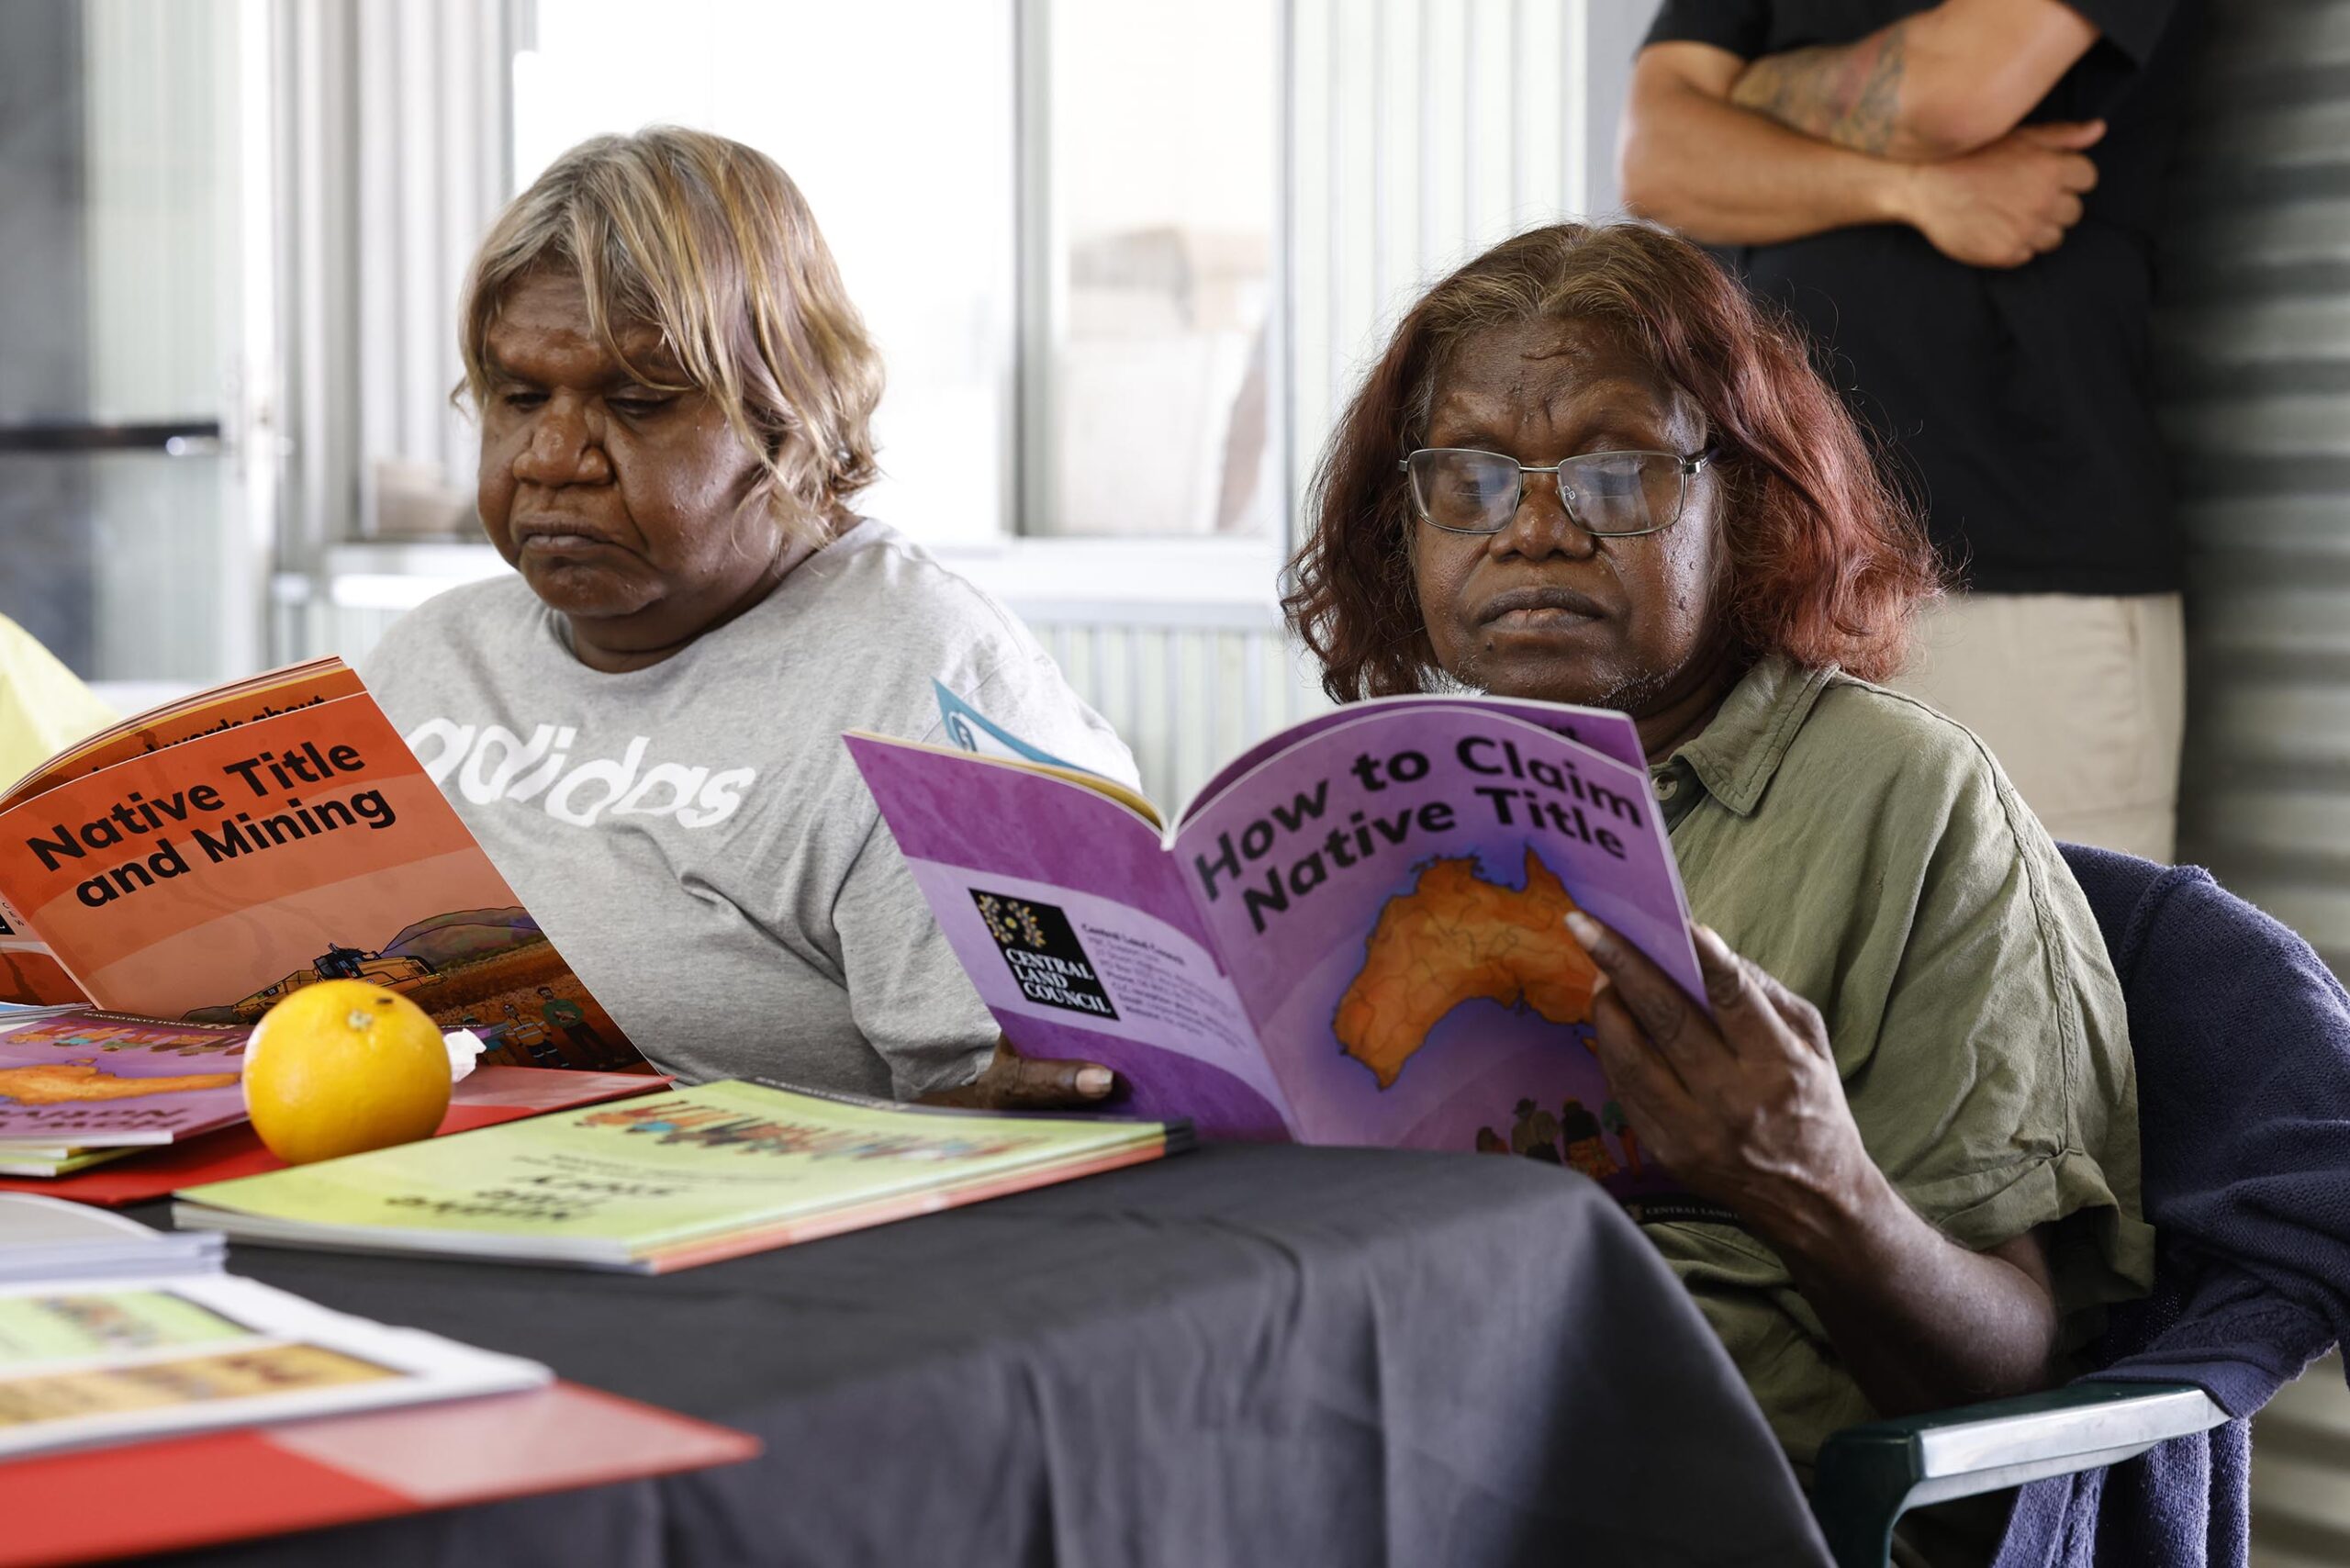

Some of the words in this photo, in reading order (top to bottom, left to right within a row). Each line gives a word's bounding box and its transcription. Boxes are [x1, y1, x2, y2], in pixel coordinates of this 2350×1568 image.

[26, 778, 225, 872] Native
[223, 740, 366, 799] Title
[405, 717, 755, 829] adidas
[1194, 778, 1330, 902] How
[1351, 748, 1430, 792] to
[1456, 736, 1644, 830] Claim
[75, 842, 191, 907] and
[190, 789, 397, 863] Mining
[1242, 801, 1457, 935] Native
[1474, 785, 1628, 860] Title
[1006, 948, 1094, 980] CENTRAL
[1013, 965, 1069, 989] LAND
[1024, 981, 1112, 1014] COUNCIL
